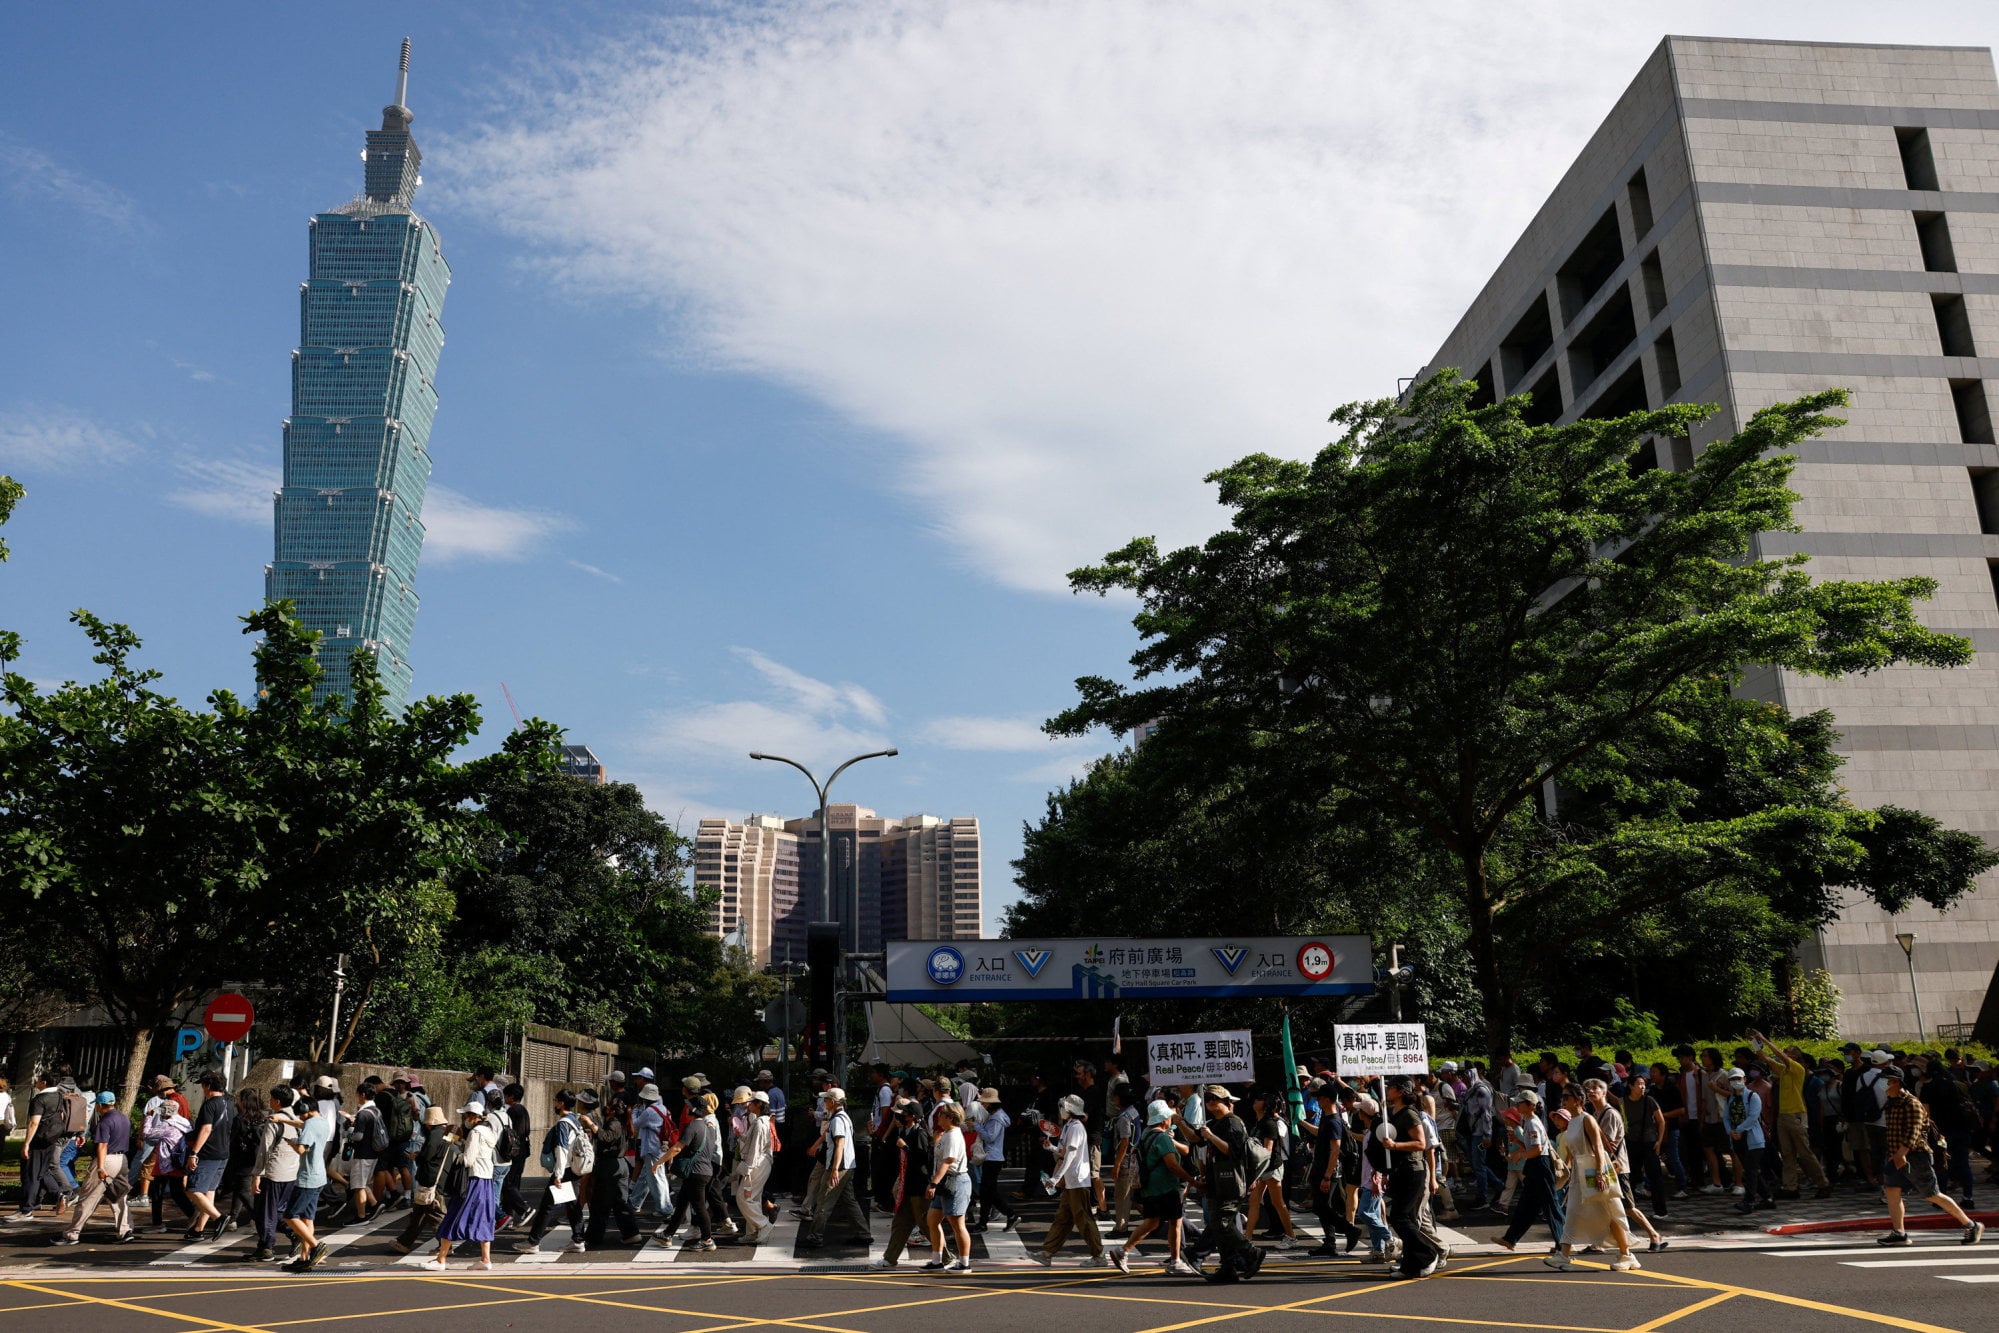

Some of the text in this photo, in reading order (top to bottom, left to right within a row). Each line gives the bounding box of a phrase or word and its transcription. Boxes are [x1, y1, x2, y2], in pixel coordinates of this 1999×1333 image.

[1108, 947, 1182, 965] 府前廣場
[1257, 953, 1285, 967] 入口
[976, 957, 1005, 972] 入口
[969, 973, 1012, 982] ENTRANCE
[1121, 968, 1171, 978] 地下停車場
[1251, 969, 1292, 978] ENTRANCE
[175, 1028, 203, 1062] P
[1341, 1055, 1359, 1064] Real
[1155, 1064, 1174, 1075] Real
